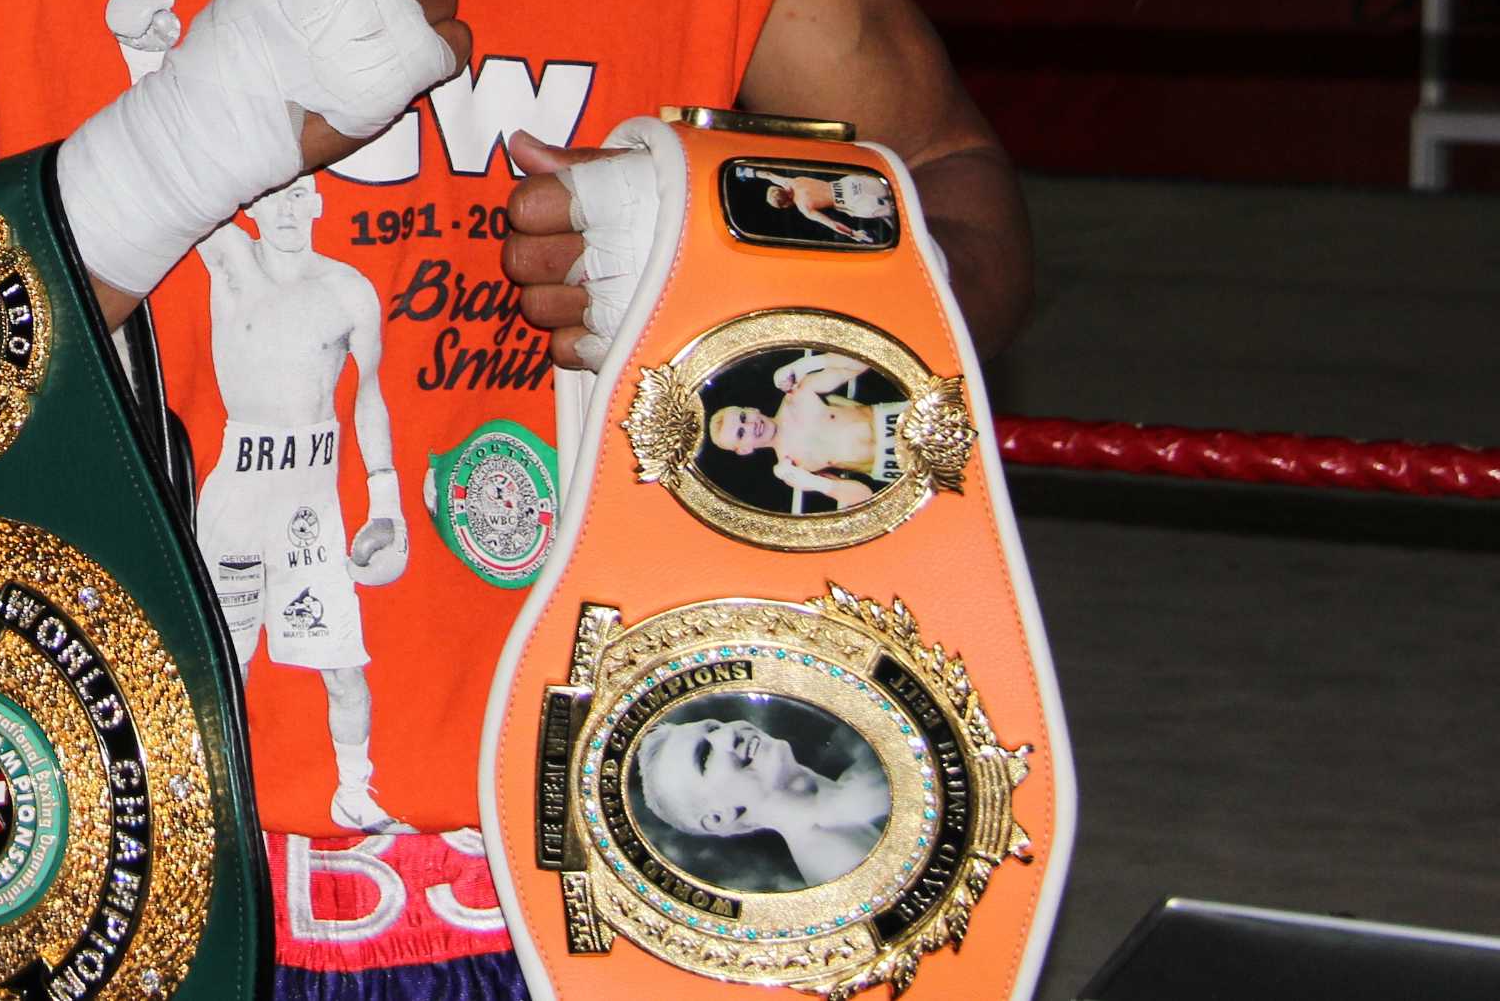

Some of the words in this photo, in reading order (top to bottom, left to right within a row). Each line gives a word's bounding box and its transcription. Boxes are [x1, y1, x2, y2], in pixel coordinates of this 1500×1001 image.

[351, 203, 442, 246] 1991
[2, 283, 31, 355] IBO
[388, 259, 522, 346] Bray
[288, 545, 328, 569] WBC
[5, 589, 124, 730] WORLD
[609, 661, 750, 751] CHAMPIONS
[35, 770, 58, 830] Boxing
[51, 759, 148, 1001] CHAMPION
